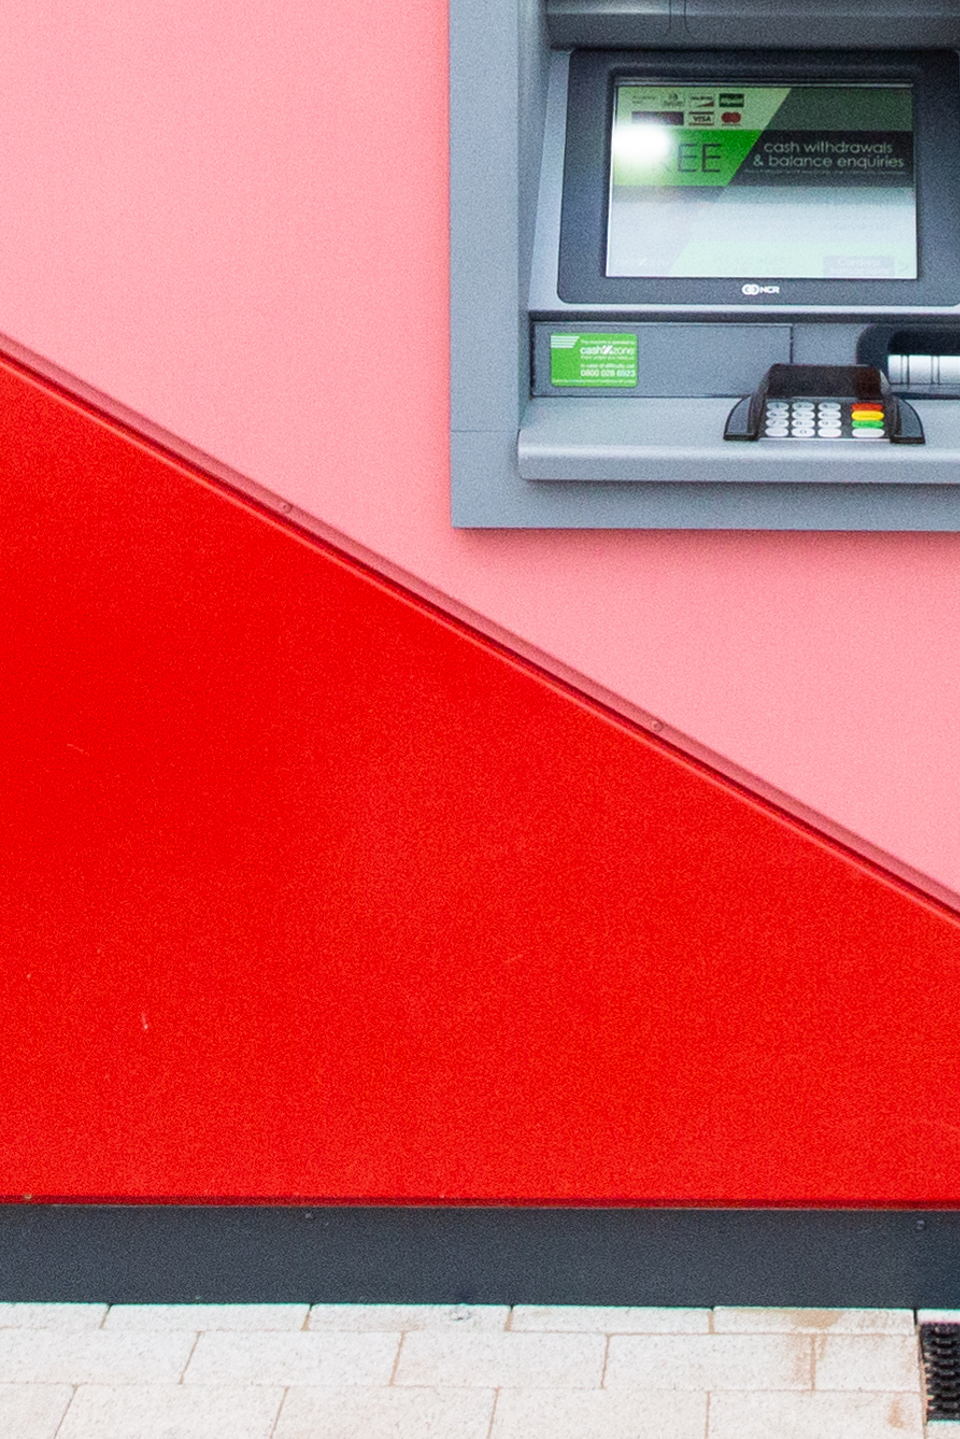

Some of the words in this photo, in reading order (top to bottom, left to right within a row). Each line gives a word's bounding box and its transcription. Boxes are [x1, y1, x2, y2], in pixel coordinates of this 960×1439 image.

[764, 141, 800, 154] cash
[803, 141, 893, 154] withdrawals
[753, 154, 764, 167] &
[768, 154, 833, 168] balance
[837, 155, 904, 170] enquiries
